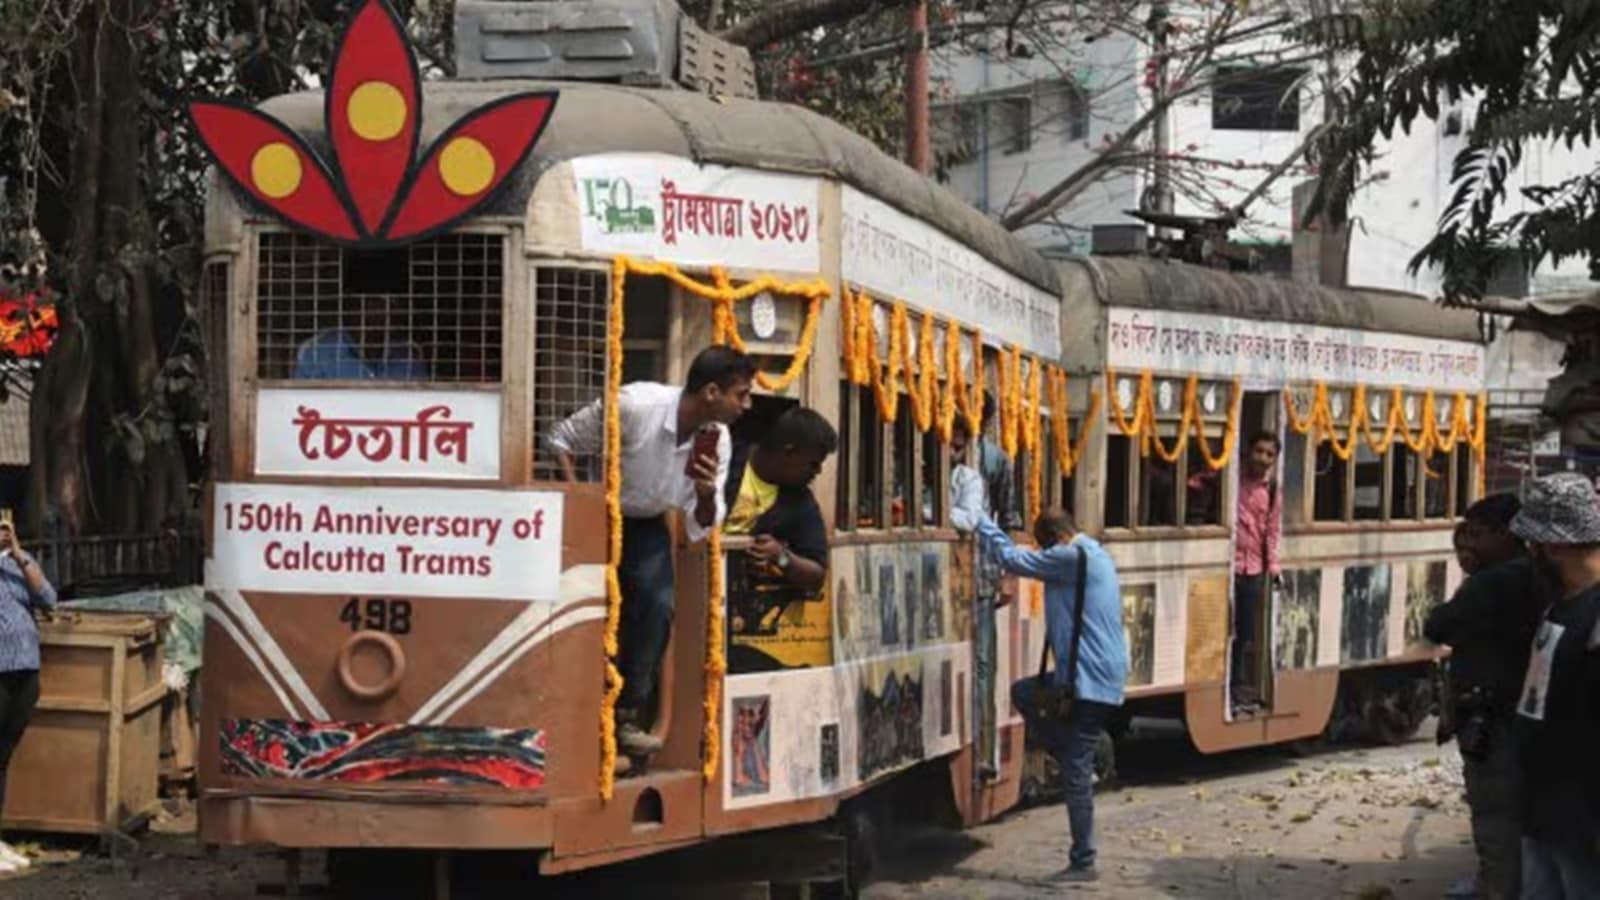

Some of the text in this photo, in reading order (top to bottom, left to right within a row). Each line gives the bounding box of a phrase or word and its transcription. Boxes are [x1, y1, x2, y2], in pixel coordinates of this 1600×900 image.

[660, 176, 809, 245] ট্রামযাত্রা ২০২৩
[292, 405, 474, 464] চৈতালি
[223, 503, 545, 546] 150th Anniversary of
[264, 541, 492, 577] Calcutta Trams
[339, 597, 412, 635] 498
